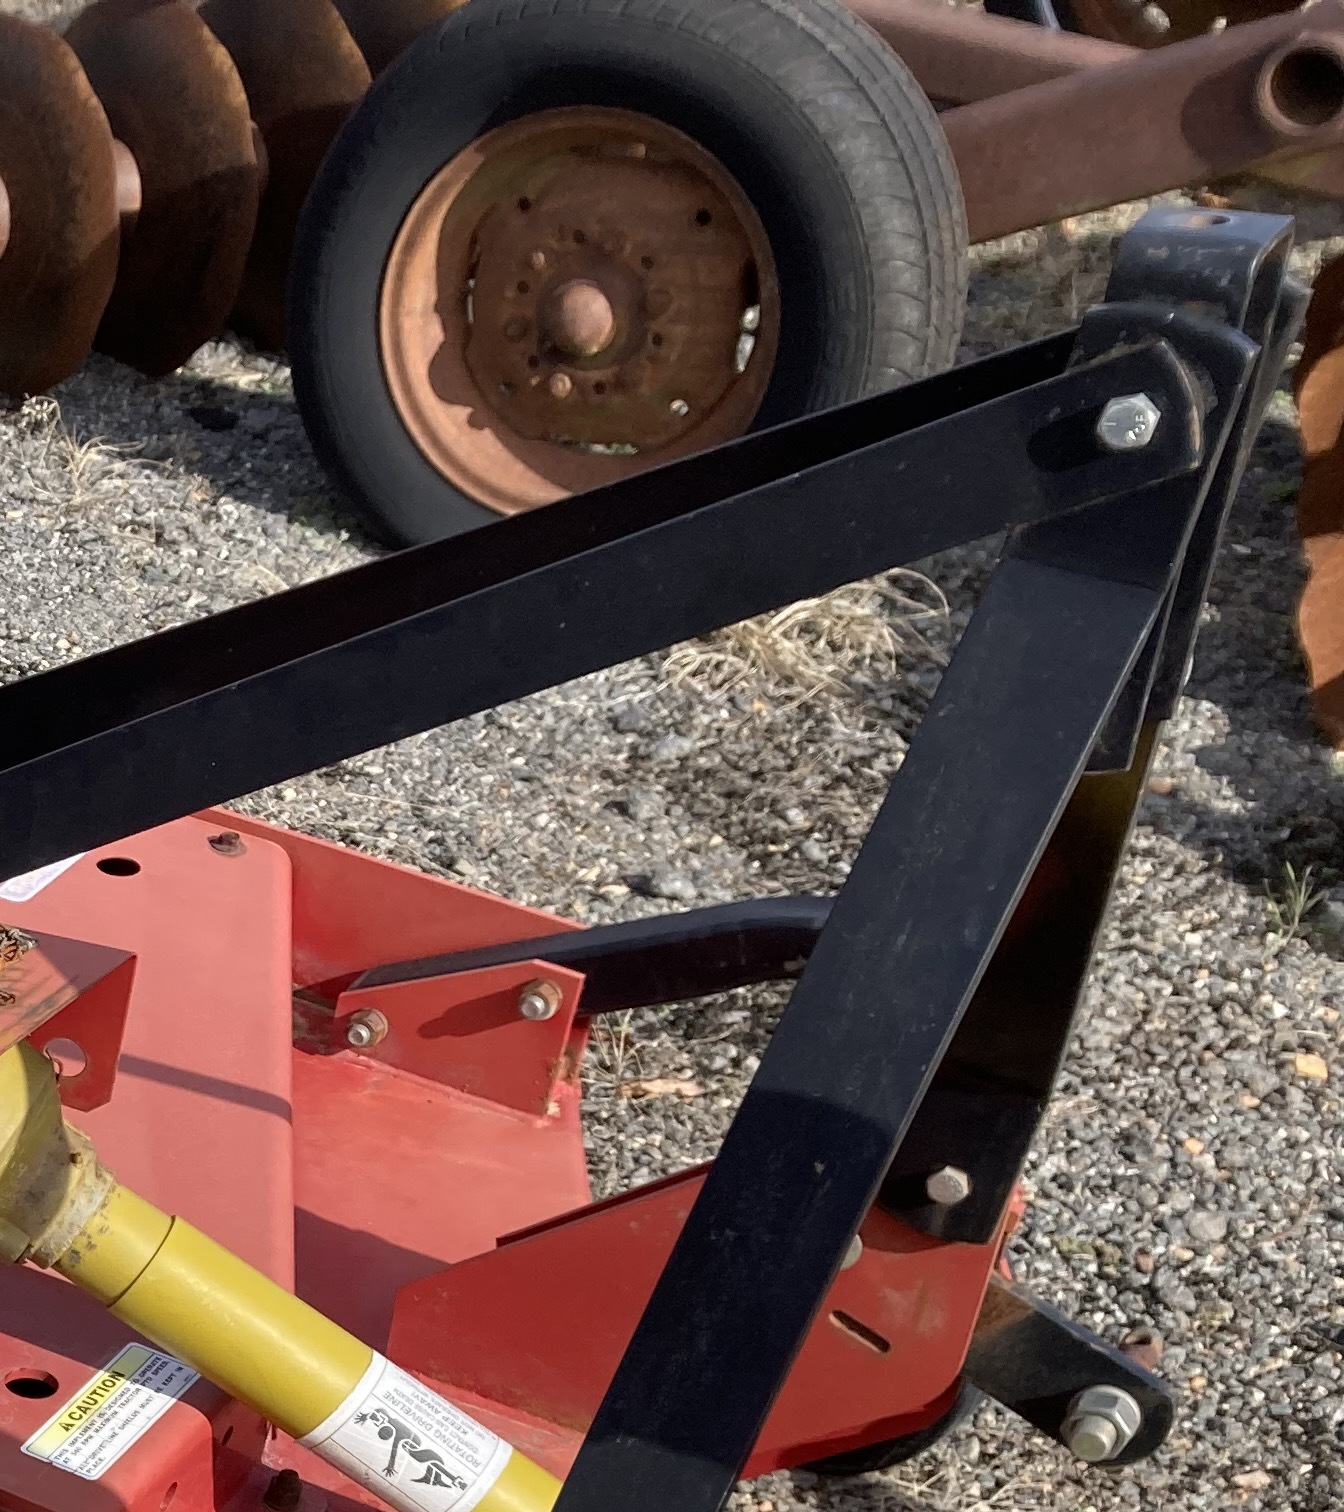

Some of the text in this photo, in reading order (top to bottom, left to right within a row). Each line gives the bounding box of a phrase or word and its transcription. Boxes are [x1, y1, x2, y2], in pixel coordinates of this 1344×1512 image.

[68, 1369, 126, 1421] CAUTION
[381, 1389, 434, 1432] DRIVELINE
[441, 1413, 469, 1436] KEEP
[432, 1428, 482, 1469] ROTATING
